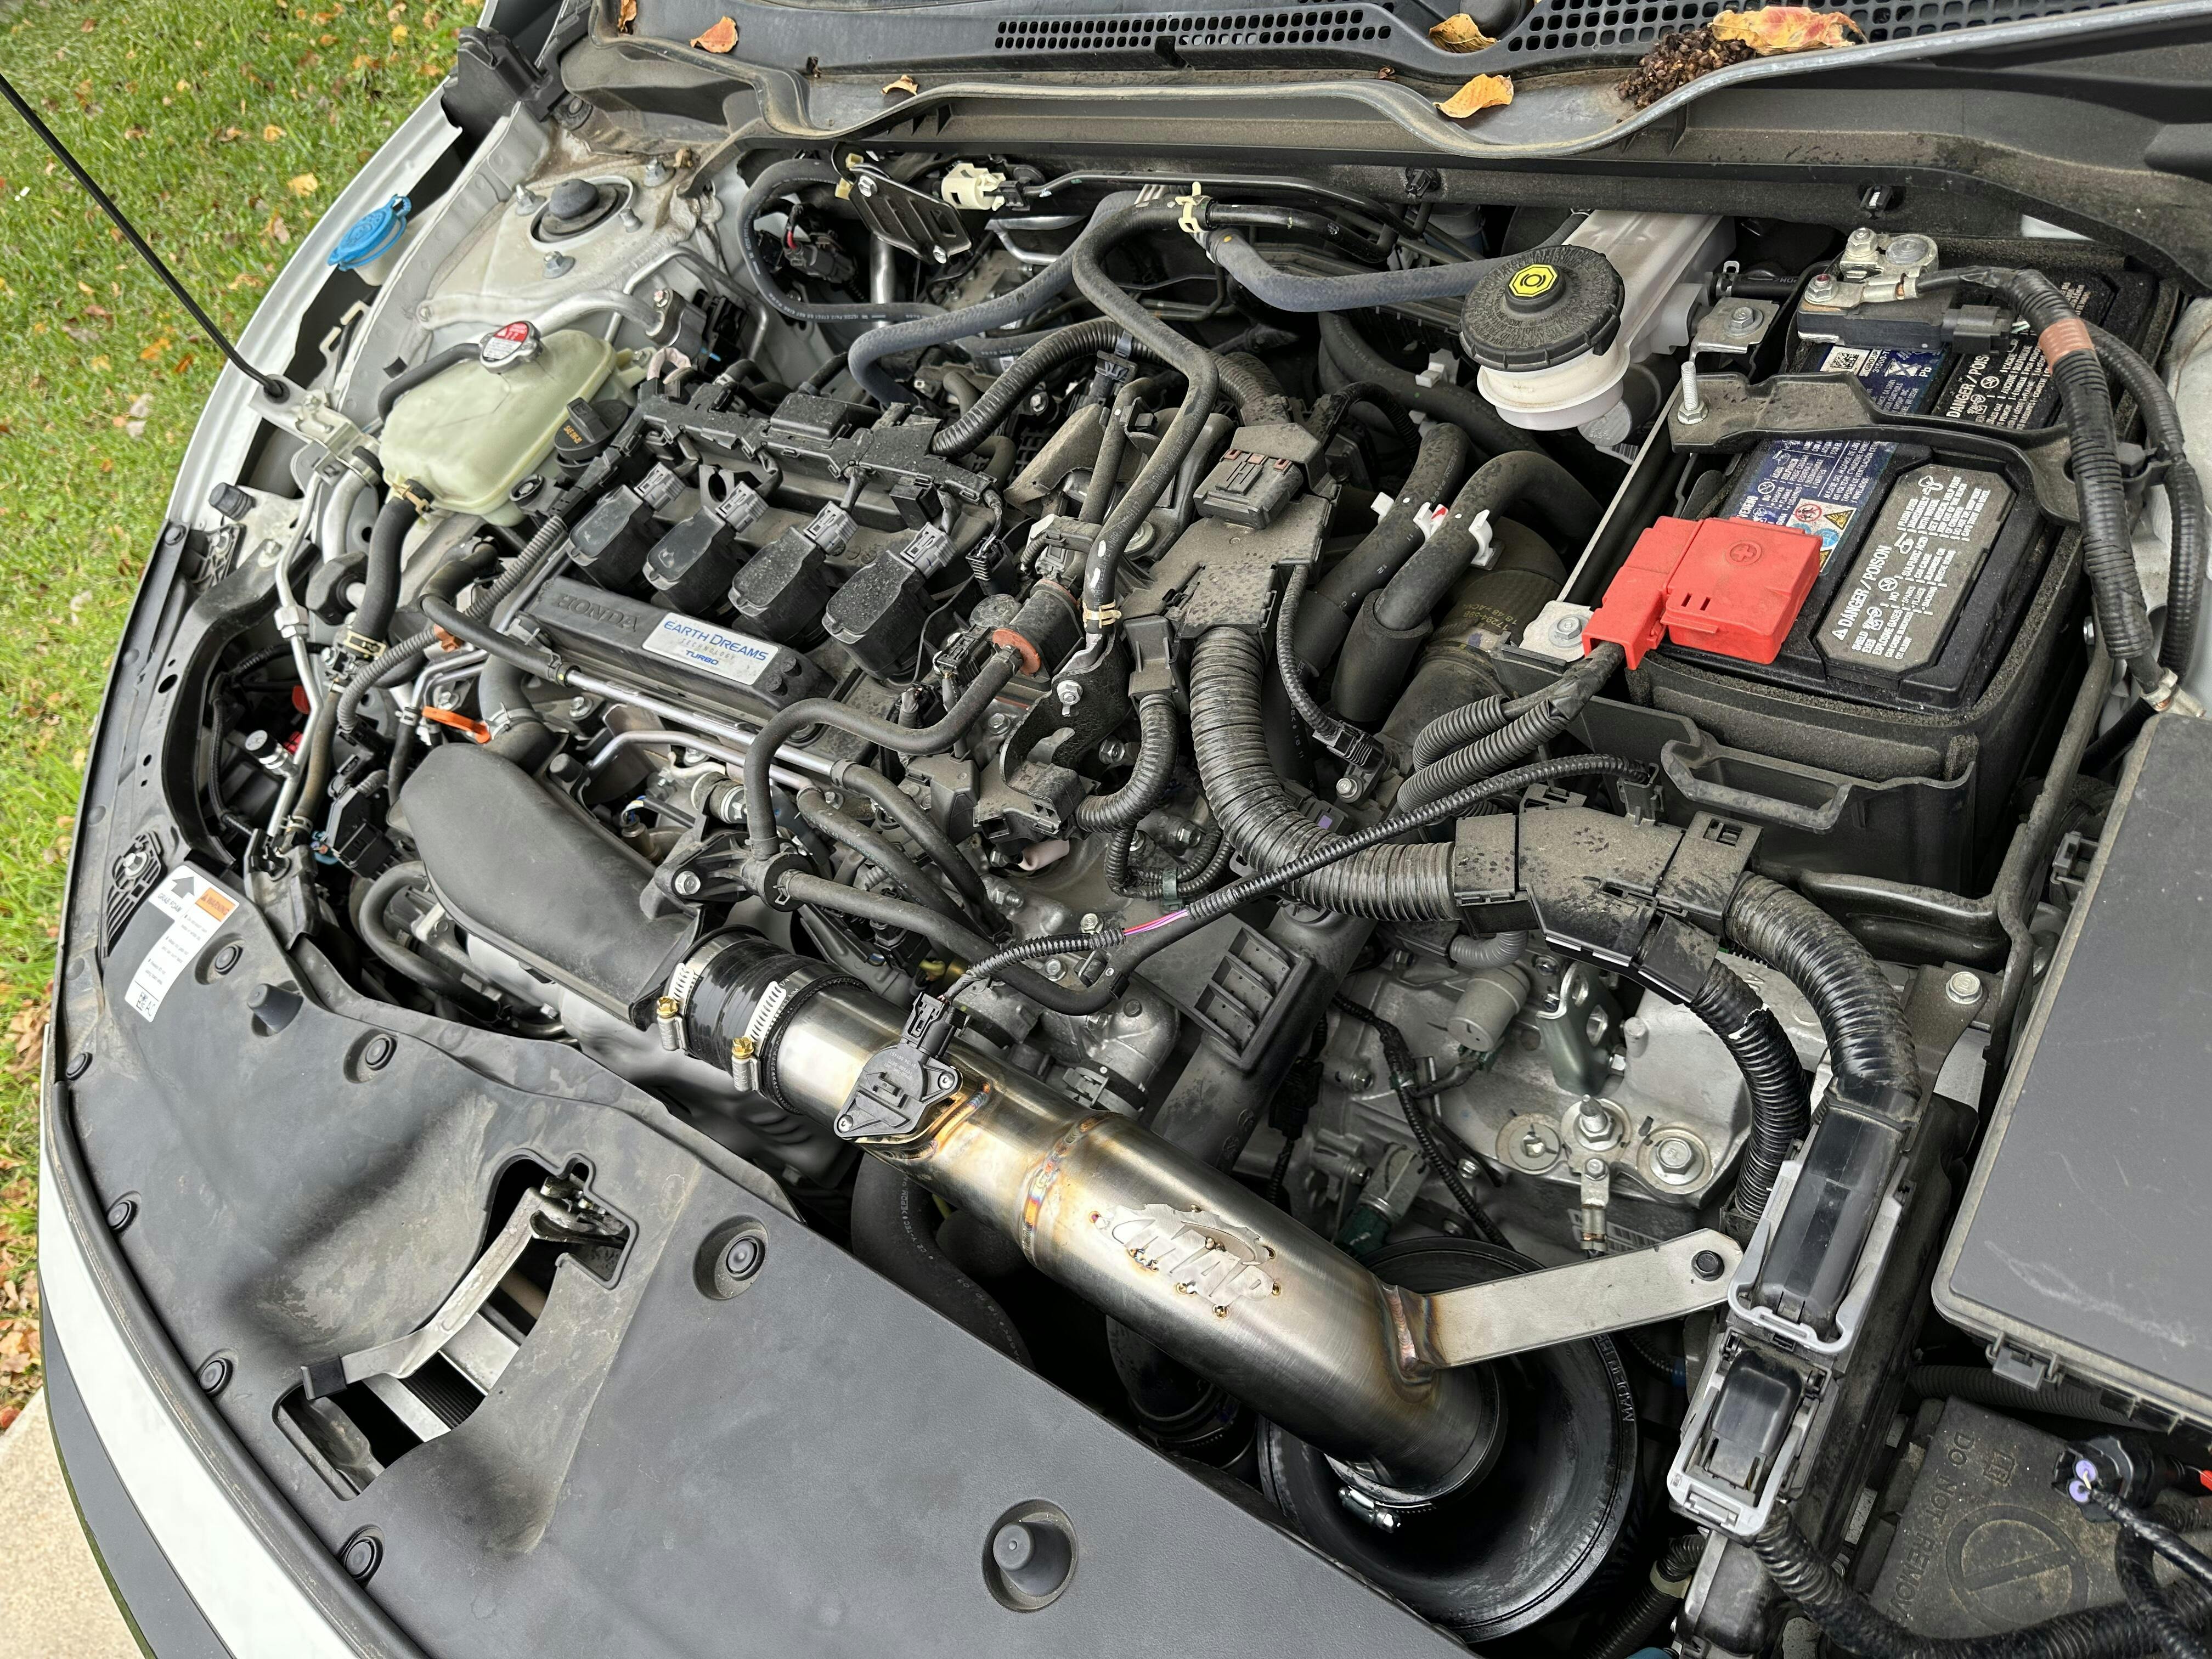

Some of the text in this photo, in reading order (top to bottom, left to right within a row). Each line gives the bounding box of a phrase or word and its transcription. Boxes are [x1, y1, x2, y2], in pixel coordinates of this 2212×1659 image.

[1864, 351, 1879, 370] GROUP
[1918, 365, 1933, 377] Pb
[1887, 382, 1904, 402] CONTROLS
[1999, 373, 2018, 394] AUCUNE
[1945, 382, 1976, 417] DANGER
[563, 424, 574, 435] SAE
[1850, 442, 1860, 450] LOS
[1836, 456, 1852, 473] ALCANCE
[1846, 453, 1864, 474] CONSERVE
[1789, 469, 1802, 481] PUEDE
[1832, 473, 1843, 482] DEL
[1771, 486, 1785, 502] CHISPAS
[1786, 486, 1803, 505] CIGARROS
[1954, 483, 1968, 497] REACH
[1737, 495, 1759, 517] VENENO
[1926, 476, 1962, 531] GET MEDICAL HELP FAST
[1949, 496, 1961, 506] THE
[1973, 502, 1984, 511] AND
[1896, 498, 1919, 526] FLUSH EYES
[1906, 496, 1931, 528] IMMEDIATELY
[1941, 512, 1953, 521] OUT
[1955, 518, 1967, 527] NOT
[1964, 499, 1977, 510] KEEP
[1966, 511, 1980, 524] TIGHT
[1916, 516, 1931, 529] WITH
[1936, 521, 1948, 533] KEEP
[1960, 524, 1973, 536] CAPS
[1900, 537, 1929, 576] SULFURIC ACID
[1913, 553, 1933, 578] CAN CAUSE
[1922, 548, 1946, 580] BLINDNESS OR
[1933, 565, 1949, 582] SEVERE
[1836, 588, 1870, 627] DANGER
[1861, 544, 1893, 580] POISON
[1901, 586, 1916, 602] SPARKS
[1887, 591, 1901, 601] NO
[1911, 588, 1927, 605] FLAMES
[1921, 585, 1939, 606] SMOKING
[555, 589, 641, 635] HONDA
[663, 618, 769, 664] EARTH DREAMS
[1850, 631, 1869, 650] SHIELD
[1871, 609, 1904, 655] EXPLOSIVE GASES
[1883, 611, 1915, 657] CAN CAUSE BLINDNESS
[679, 636, 736, 663] TECHNOLOGY
[1861, 639, 1877, 653] EYES
[684, 648, 720, 667] TURBO
[903, 1221, 917, 1241] Y-TEC
[1884, 1430, 1976, 1624] DO NOT REMOVE
